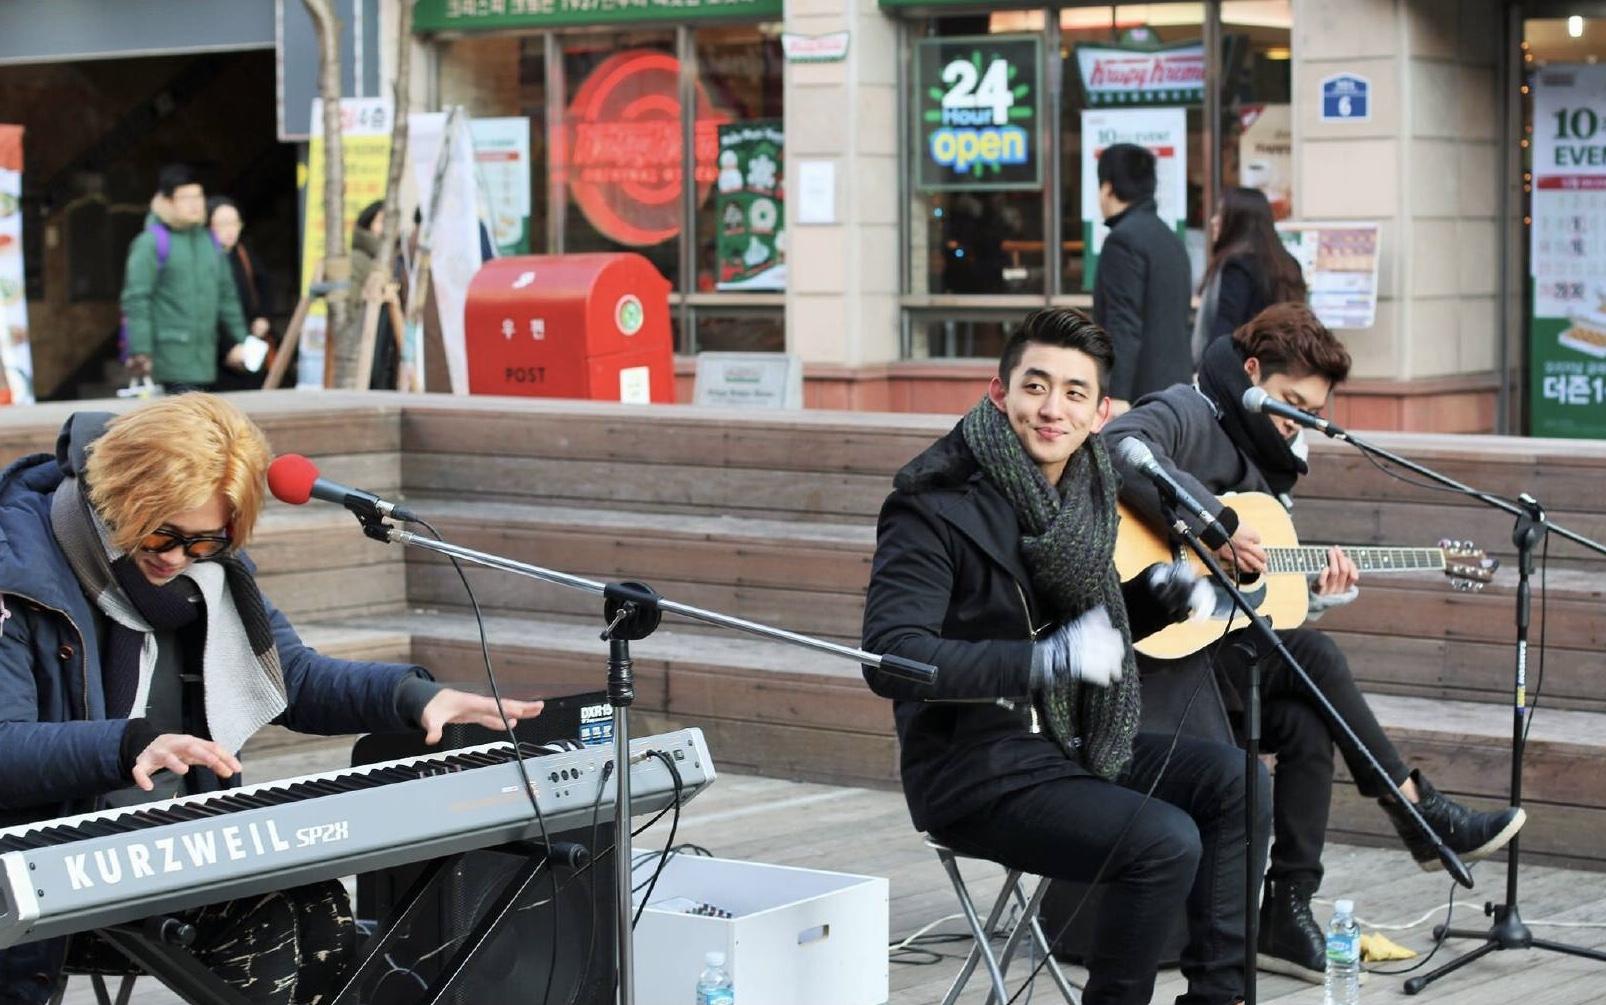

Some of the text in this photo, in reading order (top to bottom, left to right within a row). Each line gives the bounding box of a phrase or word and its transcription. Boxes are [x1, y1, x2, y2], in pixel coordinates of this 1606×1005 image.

[942, 59, 1014, 125] 24
[1338, 96, 1352, 116] 6
[1553, 107, 1598, 140] 10
[931, 128, 1027, 172] open
[1555, 145, 1606, 167] EVE
[505, 366, 546, 383] POST
[1543, 374, 1606, 405] 더즌1
[64, 819, 290, 890] KURZWEIL
